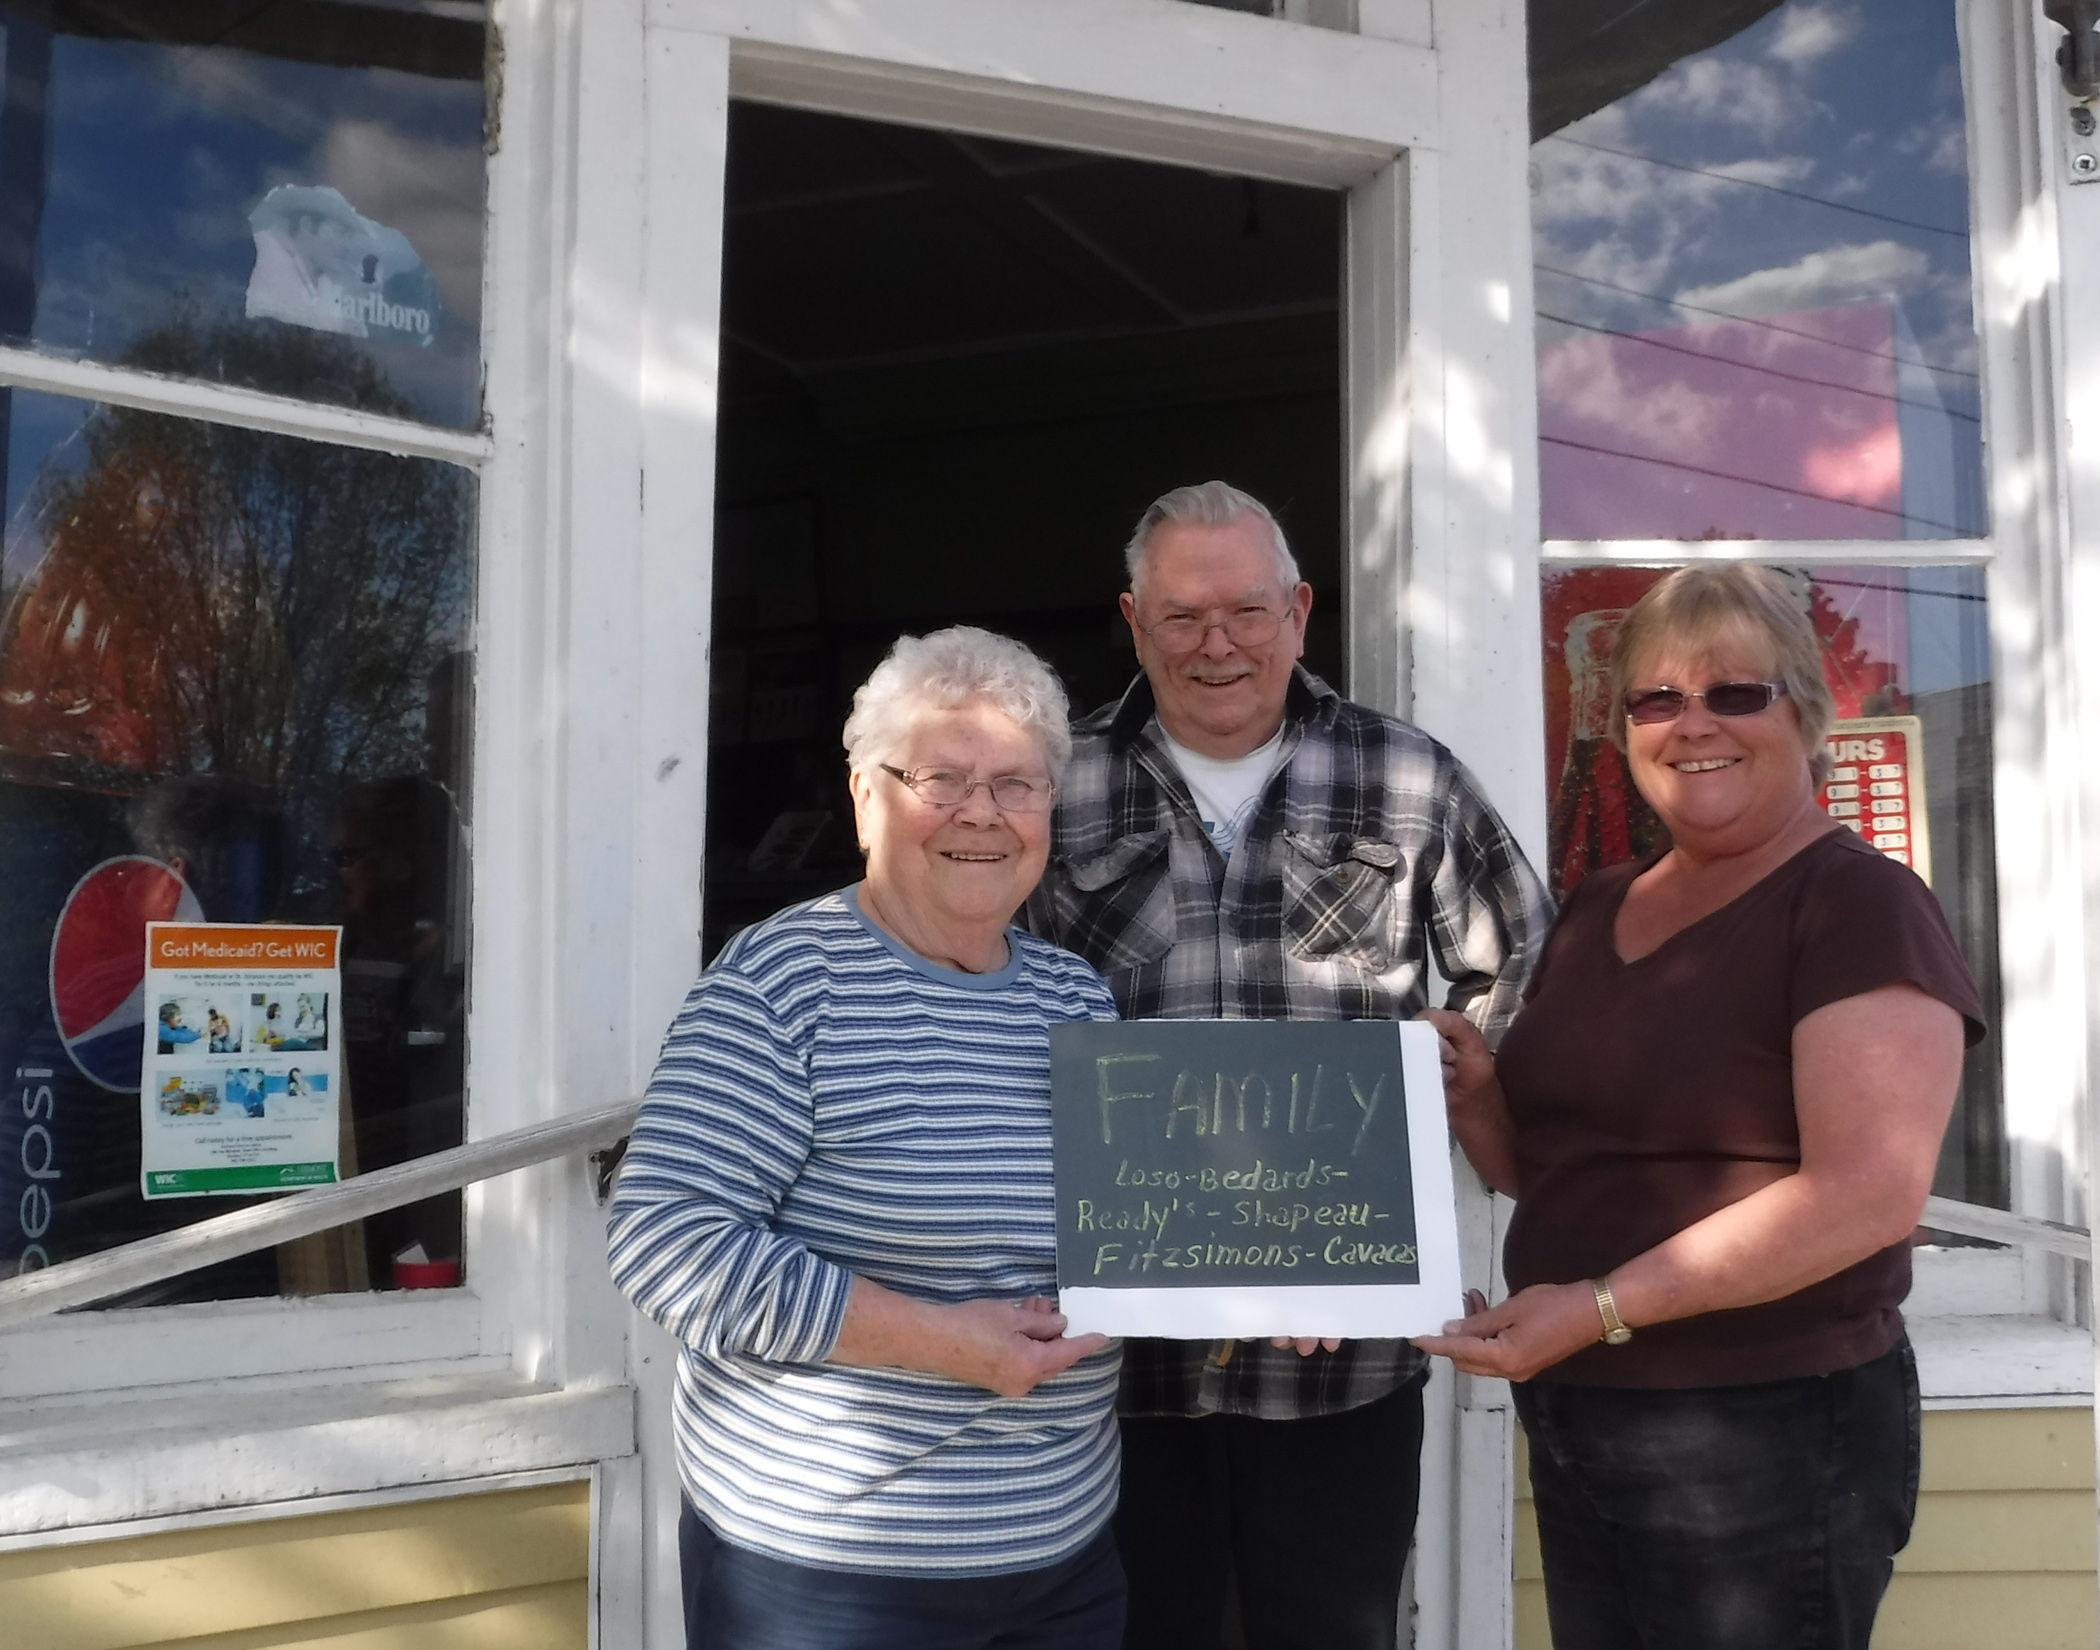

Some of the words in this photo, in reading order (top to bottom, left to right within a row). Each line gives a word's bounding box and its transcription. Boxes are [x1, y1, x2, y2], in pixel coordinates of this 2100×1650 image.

[330, 291, 430, 334] arlboro
[1827, 739, 1884, 763] URS
[161, 941, 189, 958] Got
[192, 942, 263, 959] Medicaid?
[266, 942, 292, 958] Get
[295, 942, 326, 958] WIC
[1097, 1053, 1387, 1156] FAMILY
[155, 1173, 176, 1185] WIC
